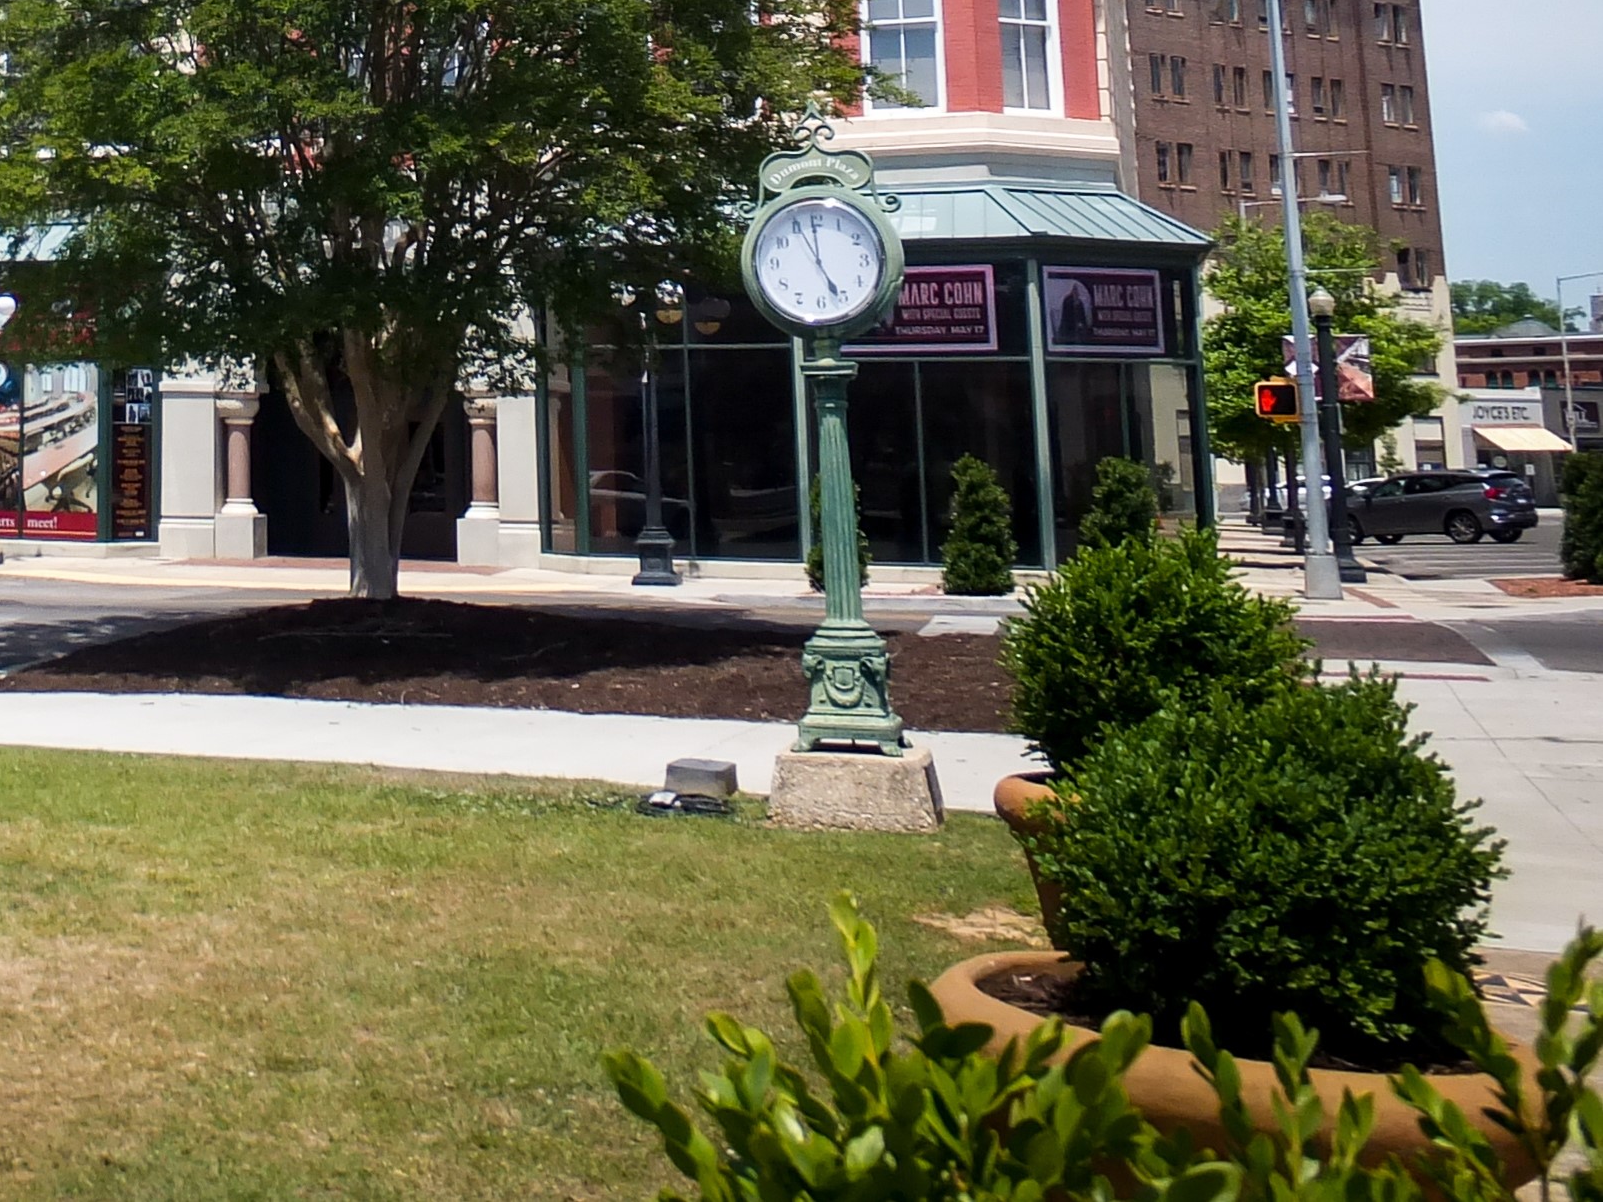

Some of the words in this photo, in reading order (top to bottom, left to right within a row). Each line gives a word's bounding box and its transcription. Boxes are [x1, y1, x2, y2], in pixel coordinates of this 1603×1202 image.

[770, 158, 822, 185] Dumont
[826, 158, 859, 180] Plaza
[776, 236, 789, 249] 10
[851, 233, 861, 246] 2
[770, 258, 779, 270] 9
[859, 254, 869, 267] 3
[899, 282, 939, 305] MARC
[943, 281, 983, 305] COHN
[817, 296, 826, 309] 6
[902, 308, 920, 320] WITH
[922, 308, 951, 320] SPECIAL
[895, 326, 947, 335] THURSDAY
[950, 325, 973, 334] MAY
[975, 325, 985, 334] 17
[27, 516, 58, 529] meet!
